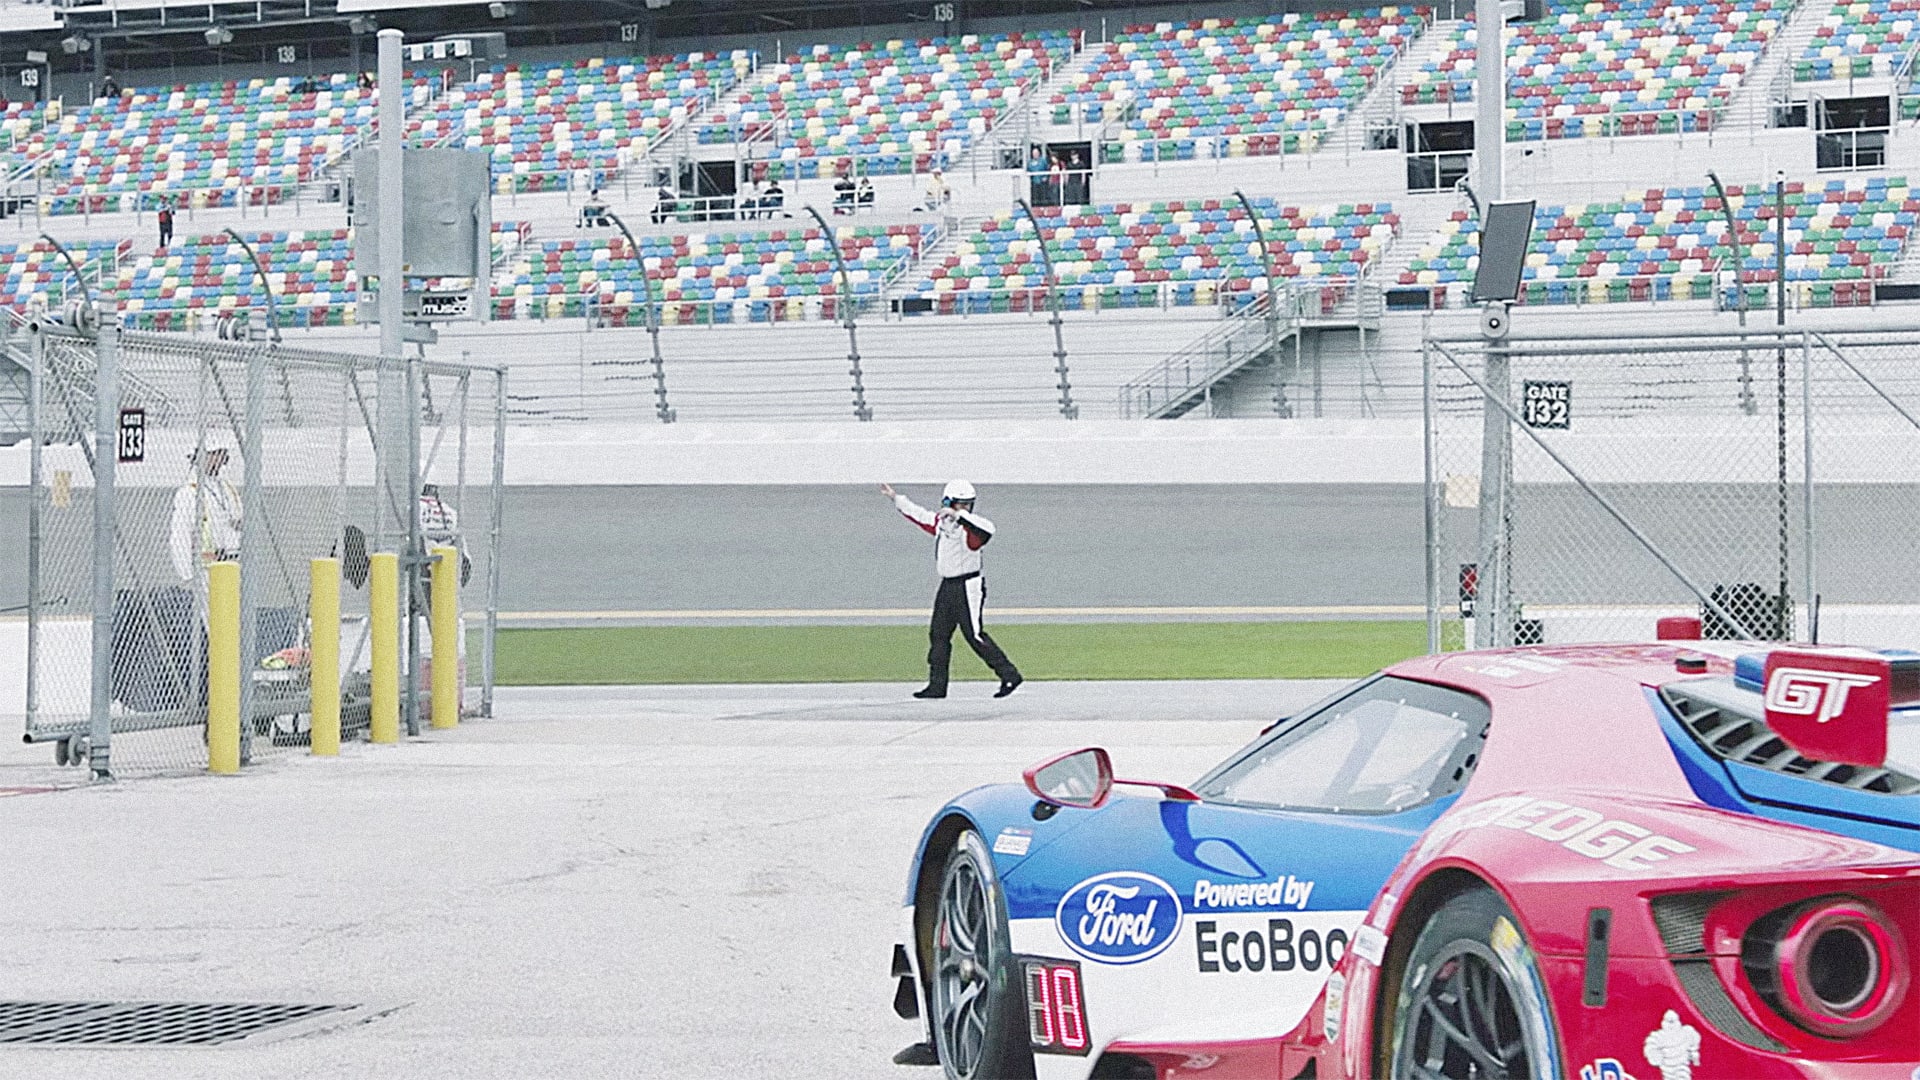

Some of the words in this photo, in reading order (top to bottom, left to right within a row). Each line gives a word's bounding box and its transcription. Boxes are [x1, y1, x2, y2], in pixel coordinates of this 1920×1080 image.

[934, 3, 954, 21] 136
[621, 24, 638, 41] 137
[278, 46, 295, 63] 138
[21, 69, 38, 86] 139
[1527, 386, 1568, 400] GATE
[1526, 400, 1567, 423] 132
[121, 428, 142, 457] 133
[1765, 667, 1882, 723] GT
[1193, 876, 1286, 908] Powered
[1284, 875, 1314, 909] by
[1078, 884, 1158, 946] Ford
